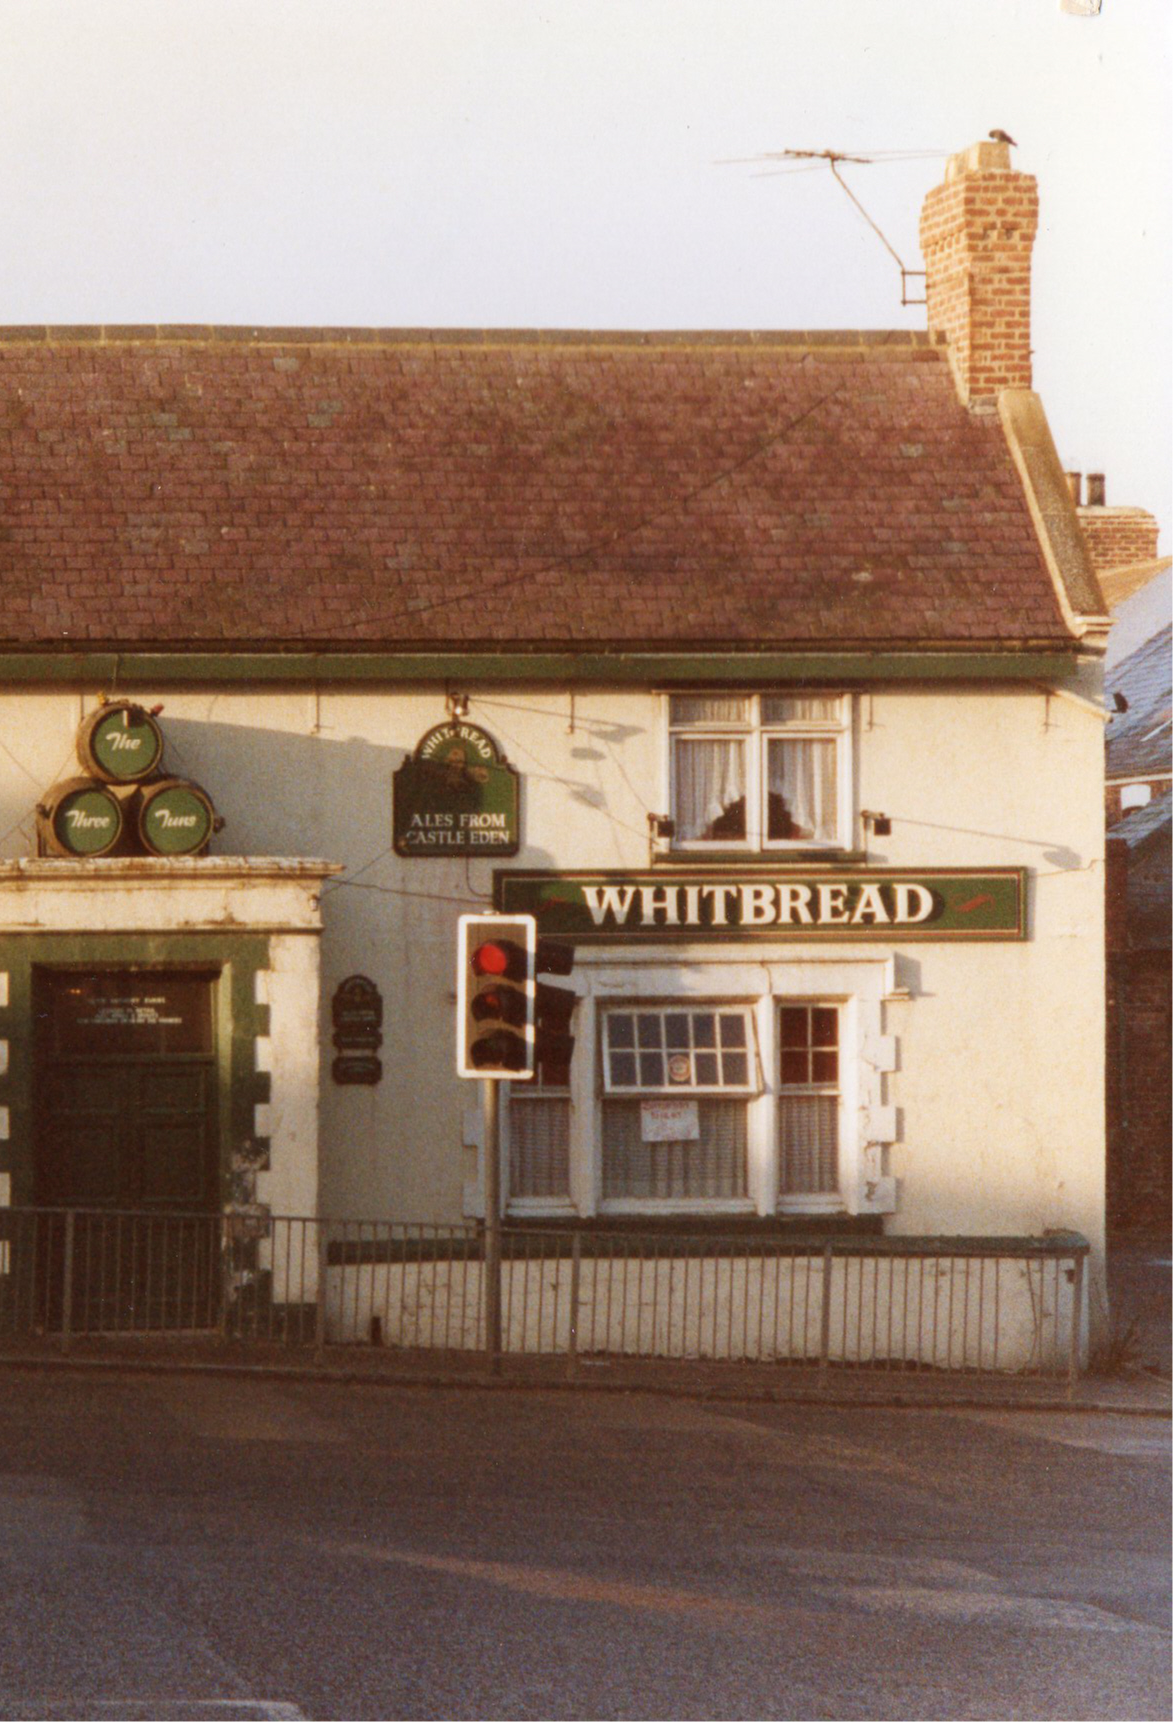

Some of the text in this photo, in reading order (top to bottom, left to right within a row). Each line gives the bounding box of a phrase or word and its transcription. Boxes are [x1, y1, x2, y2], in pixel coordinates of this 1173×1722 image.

[106, 732, 141, 750] The
[421, 727, 492, 759] WHITREAD
[65, 810, 110, 828] Three
[155, 809, 196, 828] Tuns
[411, 812, 506, 828] ALES FROM
[406, 829, 510, 845] CASTLE EDEN
[581, 883, 934, 926] WHITBREAD
